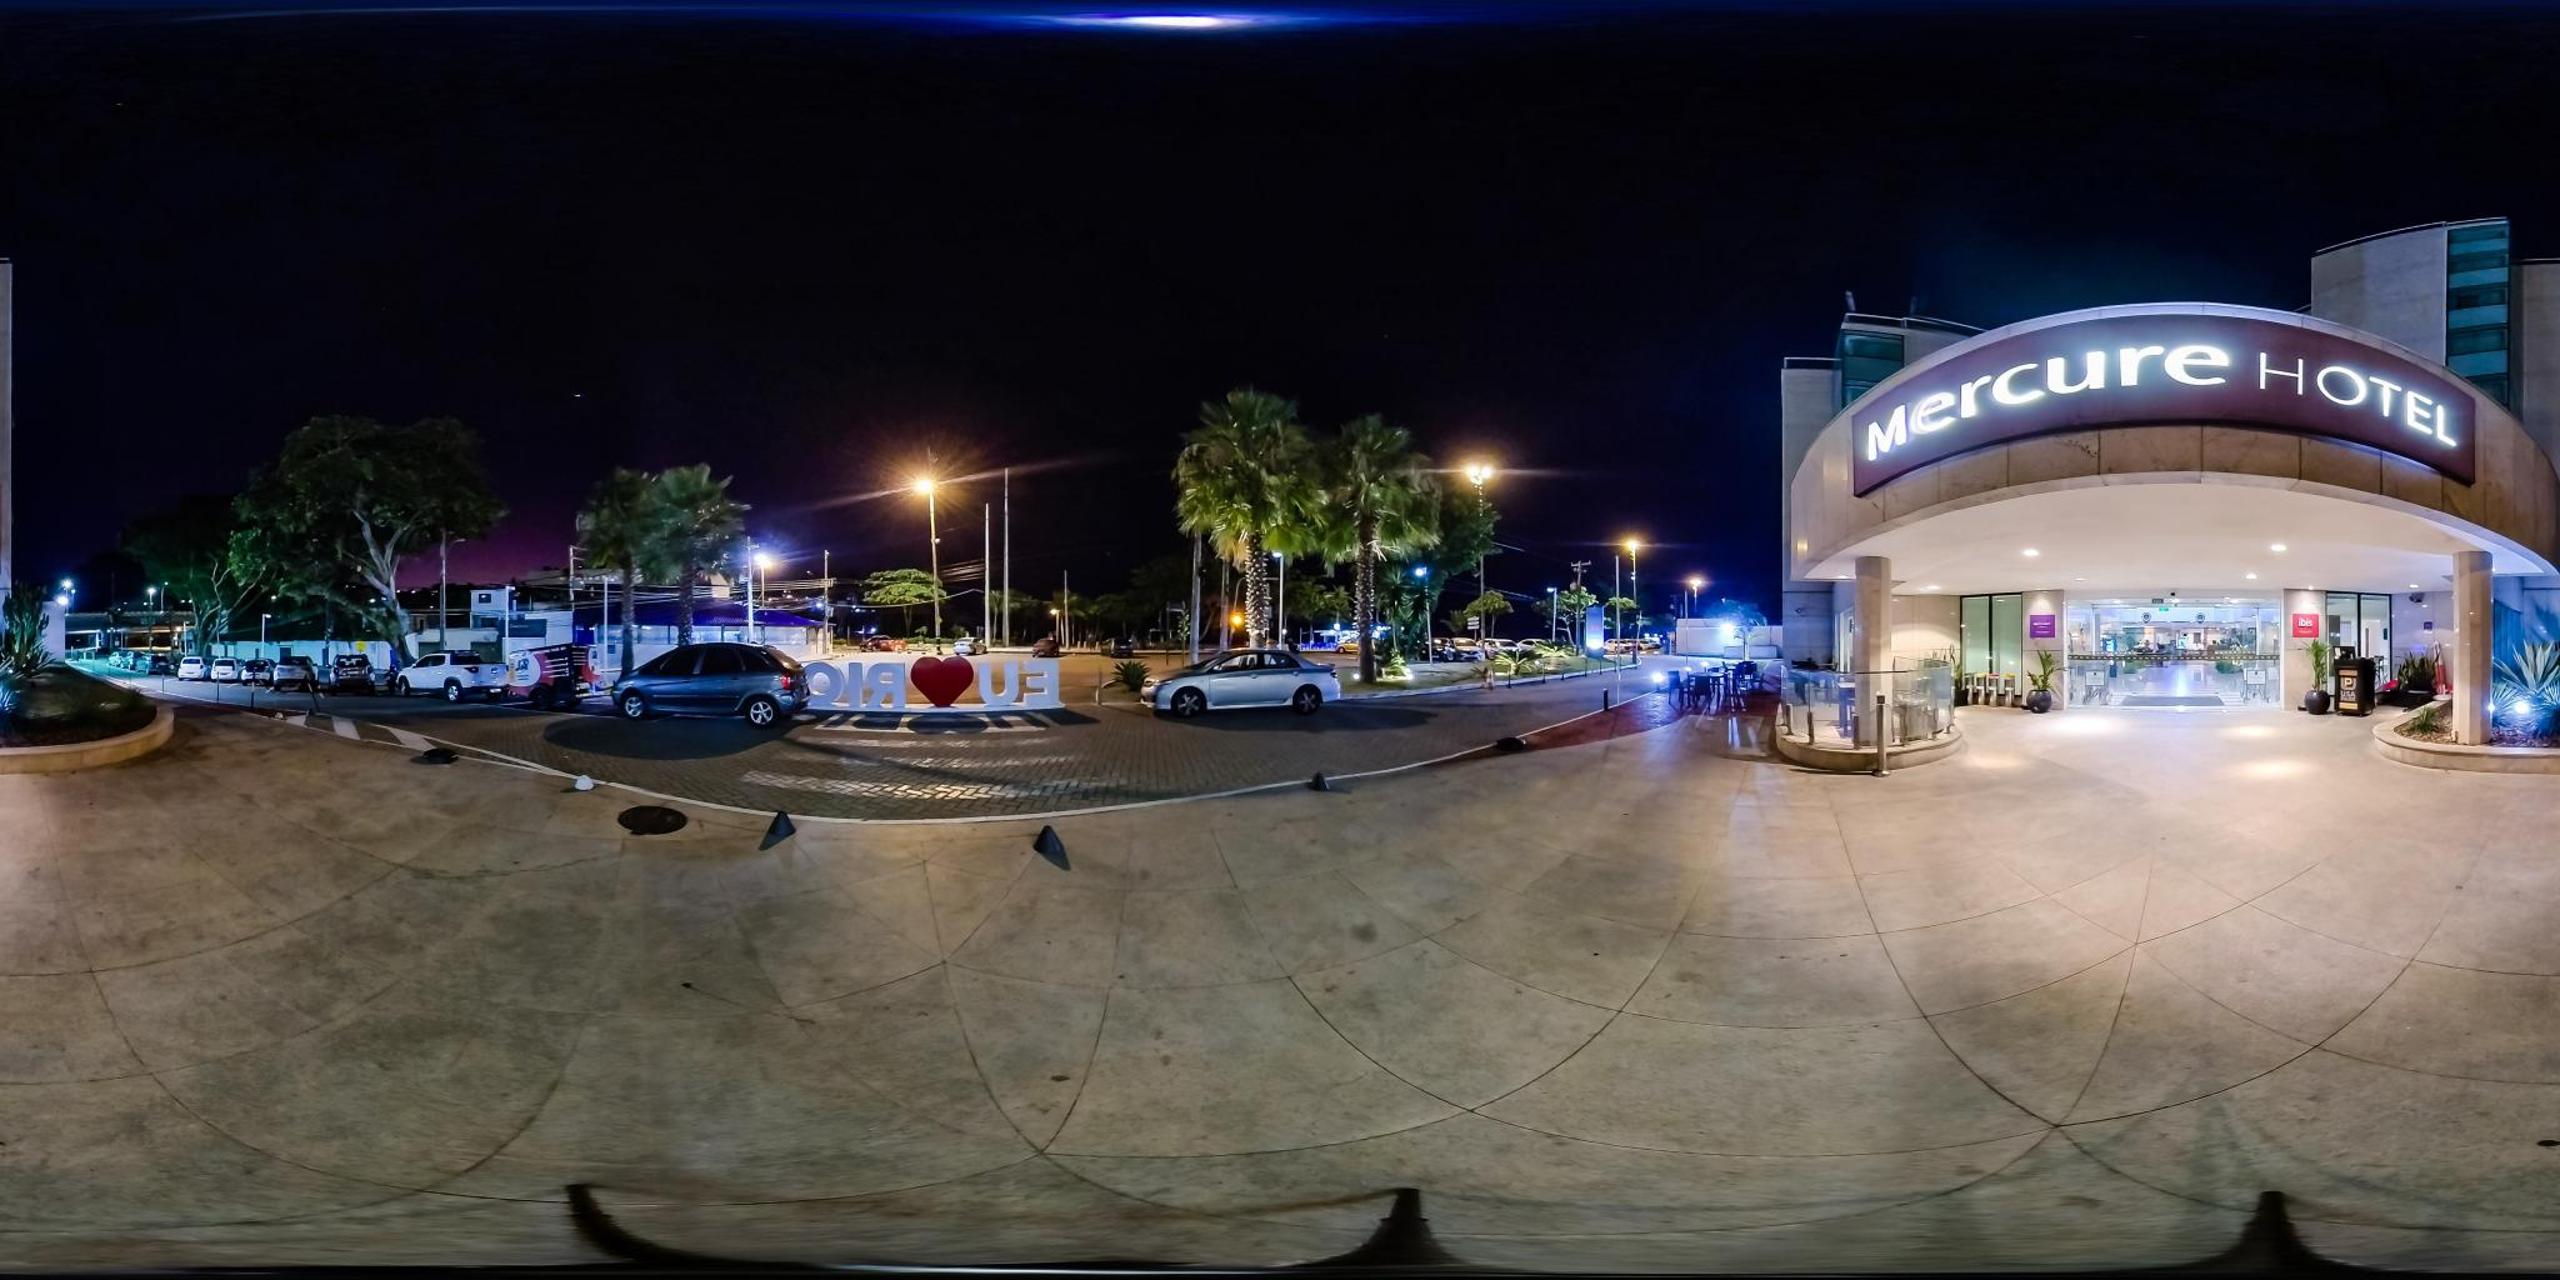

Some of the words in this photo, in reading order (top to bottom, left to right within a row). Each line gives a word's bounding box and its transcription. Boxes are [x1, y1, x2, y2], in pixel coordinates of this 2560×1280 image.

[1867, 344, 2230, 461] Mercure
[2259, 352, 2457, 448] HOTEL
[2298, 617, 2313, 627] ibis
